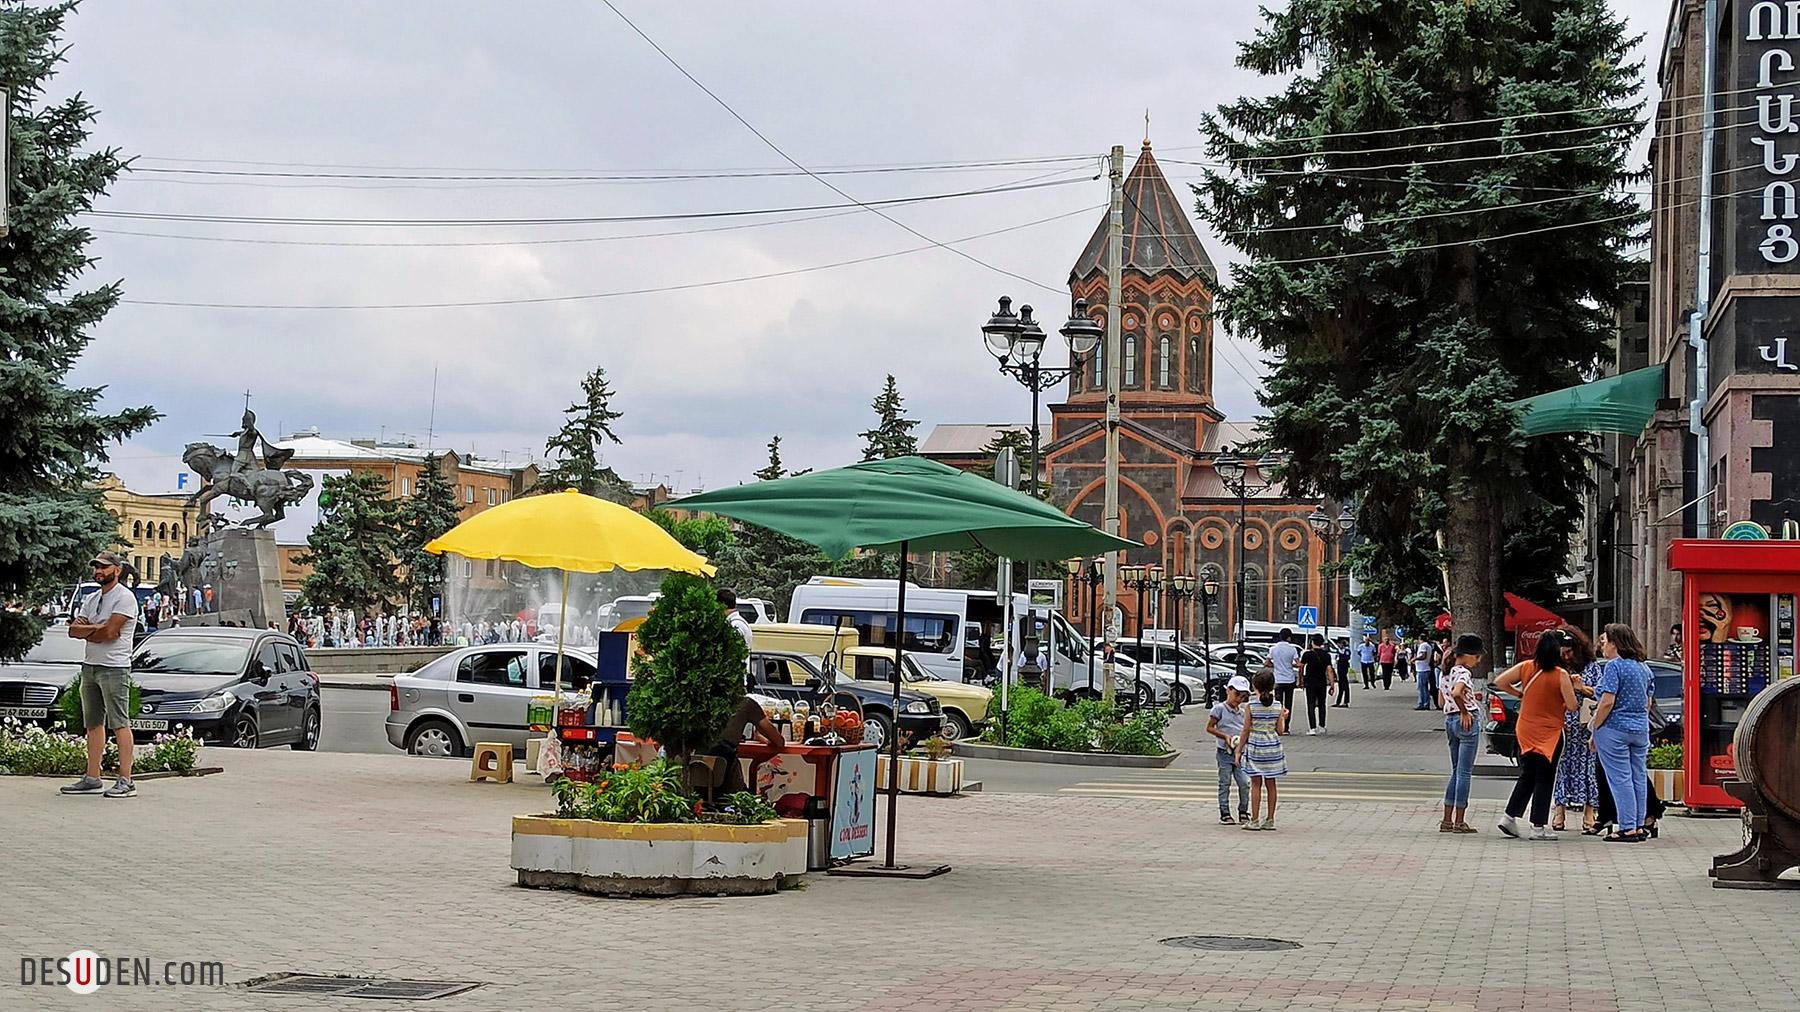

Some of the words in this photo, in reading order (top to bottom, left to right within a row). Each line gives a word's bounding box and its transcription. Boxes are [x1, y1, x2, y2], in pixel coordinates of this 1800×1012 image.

[178, 473, 188, 489] F
[18, 709, 30, 717] RR
[31, 709, 45, 717] 666
[140, 720, 151, 729] VG
[152, 721, 167, 730] 507
